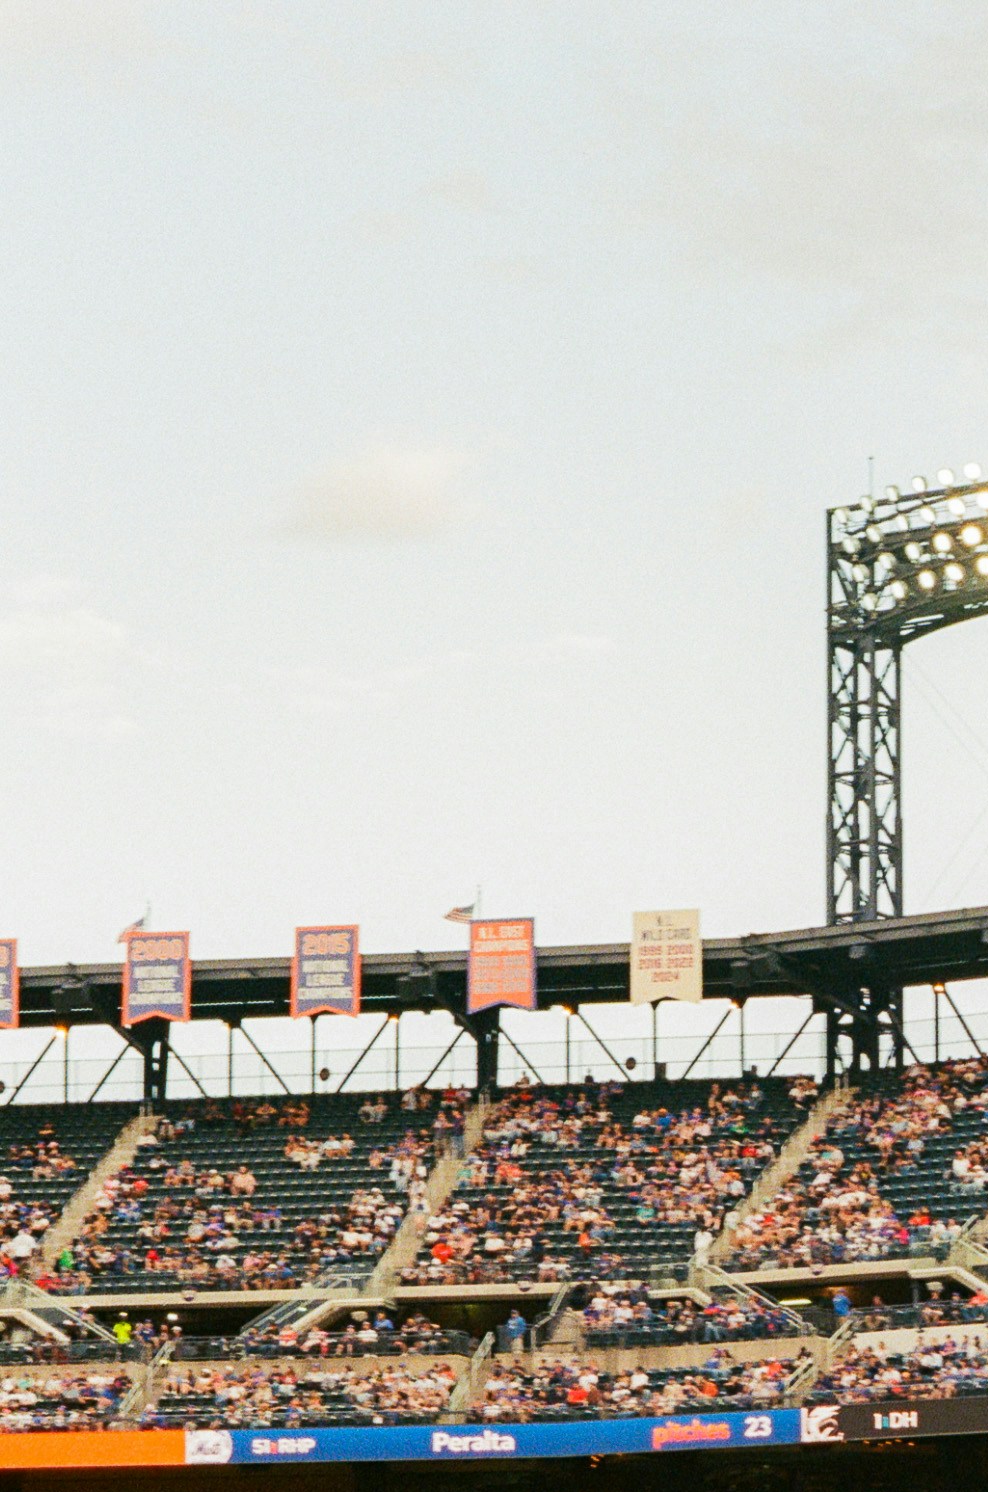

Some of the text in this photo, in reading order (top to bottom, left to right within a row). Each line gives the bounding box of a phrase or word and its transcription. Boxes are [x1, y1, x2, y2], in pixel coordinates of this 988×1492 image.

[130, 938, 184, 961] 2000
[300, 932, 352, 956] 2015
[432, 1430, 515, 1452] Peralta
[652, 1418, 731, 1449] pitches
[744, 1416, 772, 1438] 23
